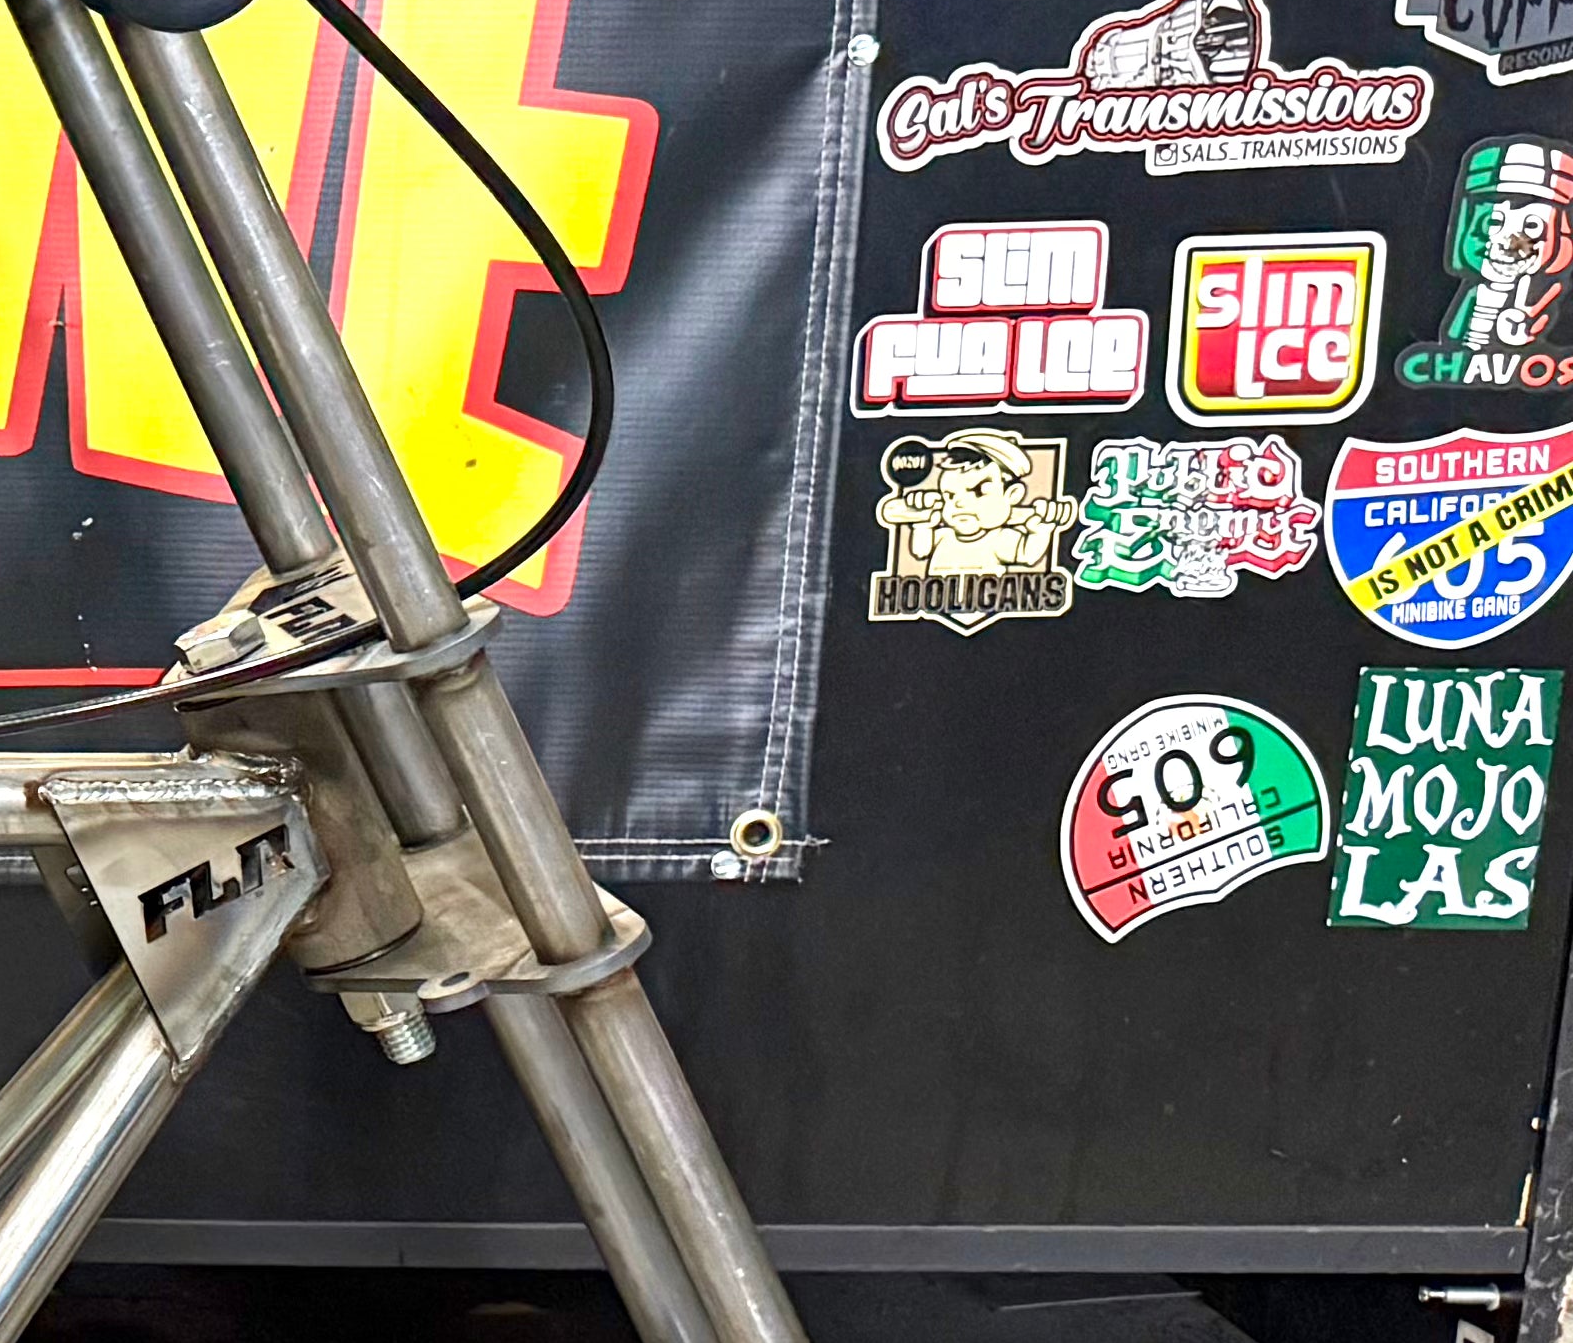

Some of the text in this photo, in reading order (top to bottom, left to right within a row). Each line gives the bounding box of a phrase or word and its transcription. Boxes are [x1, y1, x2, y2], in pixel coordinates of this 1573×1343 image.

[891, 74, 1420, 161] Sal's Transmissions
[1181, 134, 1400, 165] SALS_TRANSMISSIONS
[1403, 353, 1573, 387] CHAVOS
[1099, 444, 1295, 507] Public
[1375, 444, 1551, 484] SOUTHERN
[1364, 491, 1514, 527] CALIFO
[1368, 468, 1573, 600] IS NOT A CRIM
[876, 574, 1067, 614] HOOLIGANS
[1391, 594, 1521, 624] MINIBIKE GANG
[1106, 715, 1224, 771] MINIBIKE GANG
[1365, 669, 1554, 753] LUNA
[1096, 726, 1256, 839] 605
[1345, 756, 1546, 841] MOJO
[1108, 786, 1281, 870] CALIFORNIA
[1128, 825, 1285, 905] SOUTHERN
[1338, 841, 1539, 924] LAS
